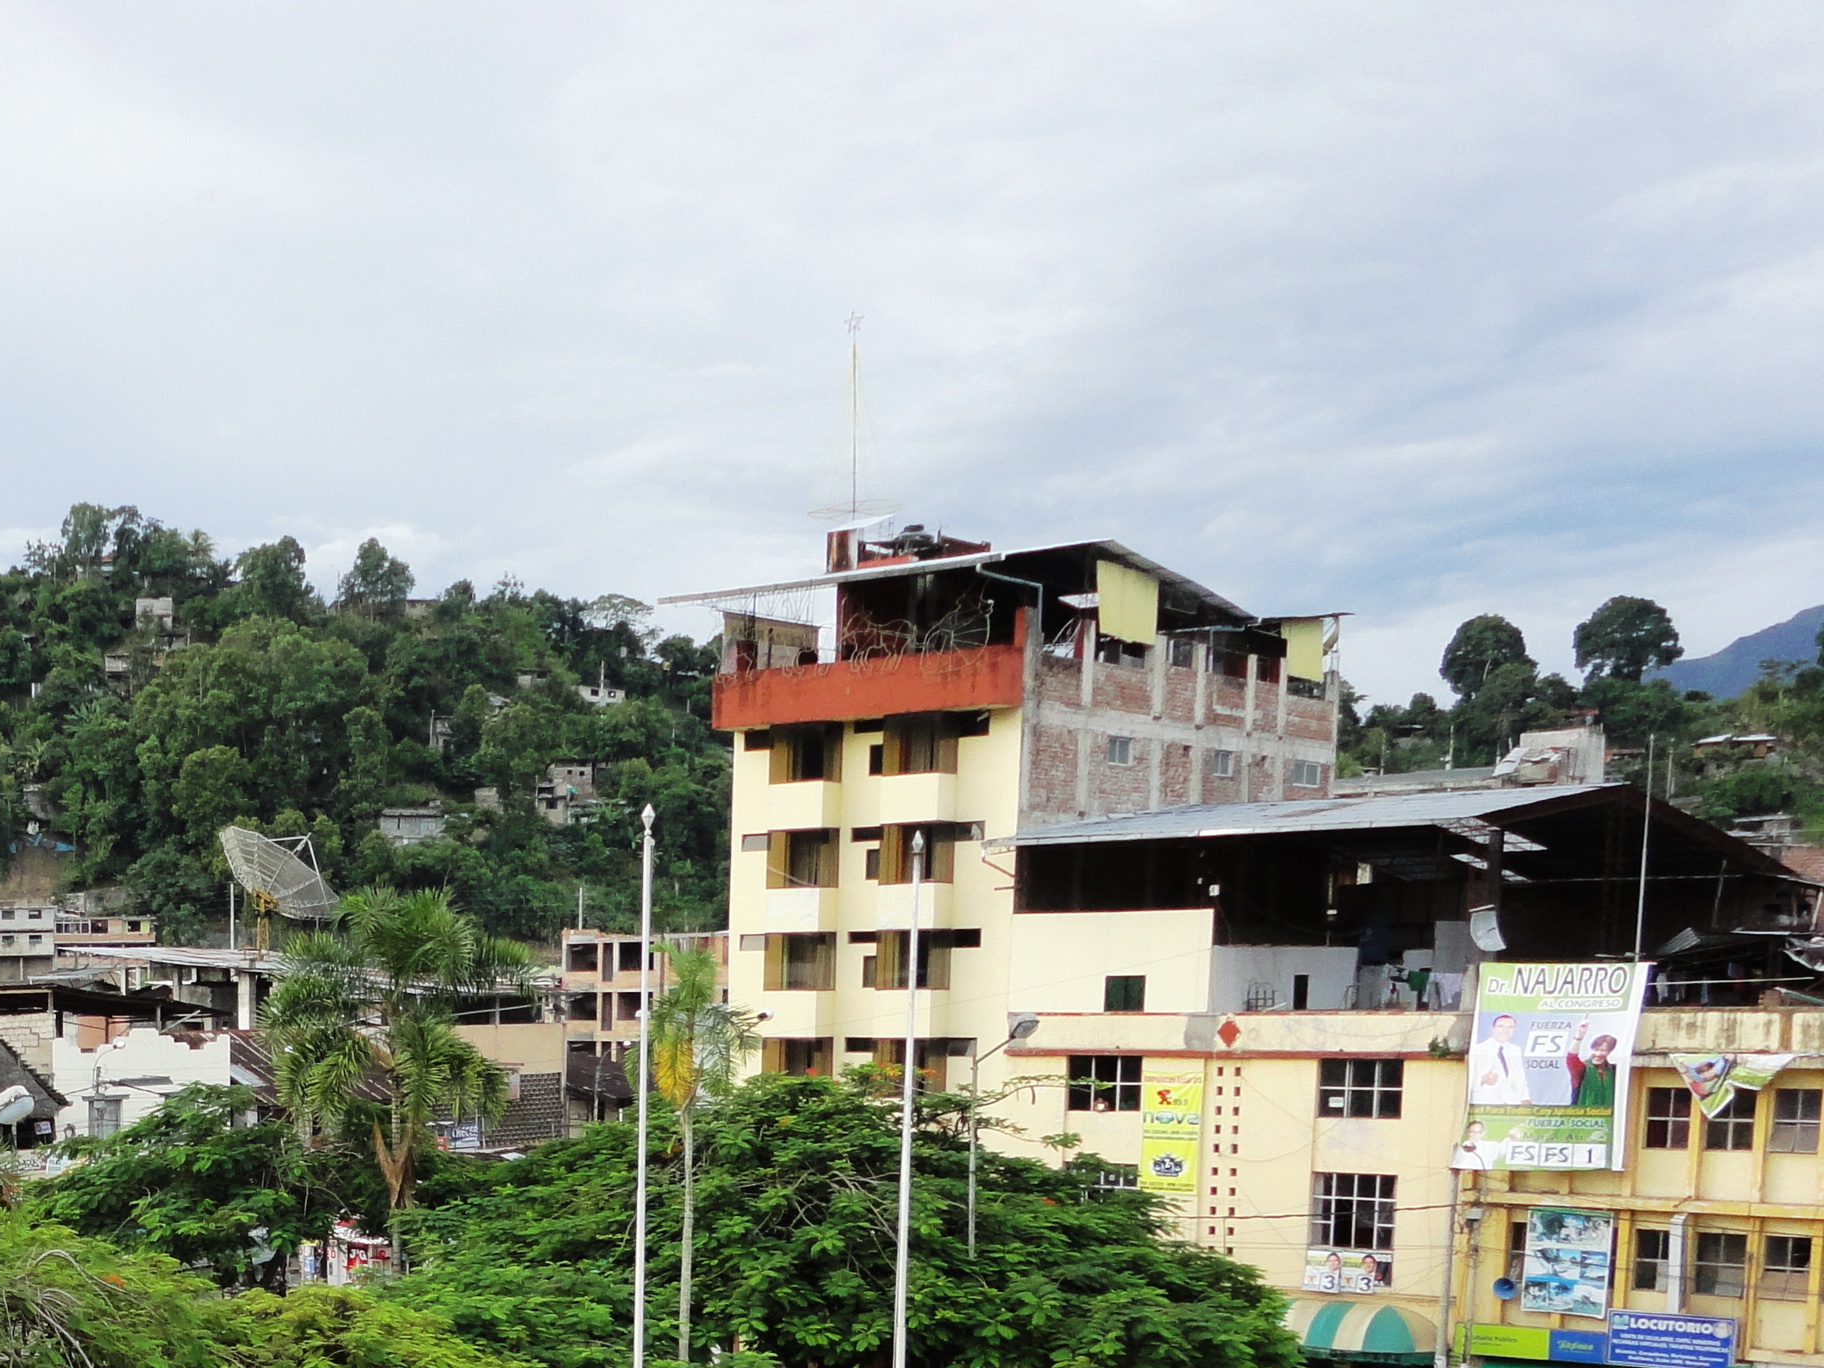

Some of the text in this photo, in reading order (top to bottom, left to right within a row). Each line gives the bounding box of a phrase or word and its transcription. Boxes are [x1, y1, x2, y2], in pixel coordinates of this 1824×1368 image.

[1488, 966, 1627, 995] Dr. NAJARRO
[1540, 999, 1621, 1009] AL CONGRESO
[1530, 1021, 1572, 1030] FUERZA
[1529, 1034, 1565, 1054] FS
[1526, 1059, 1560, 1069] SOCIAL
[1143, 1110, 1201, 1126] nova
[1527, 1119, 1606, 1128] FUERZA SOCIAL
[1509, 1145, 1594, 1164] FS FS 1
[1322, 1274, 1373, 1292] 3 3
[1629, 1317, 1714, 1335] LOCUTORIO
